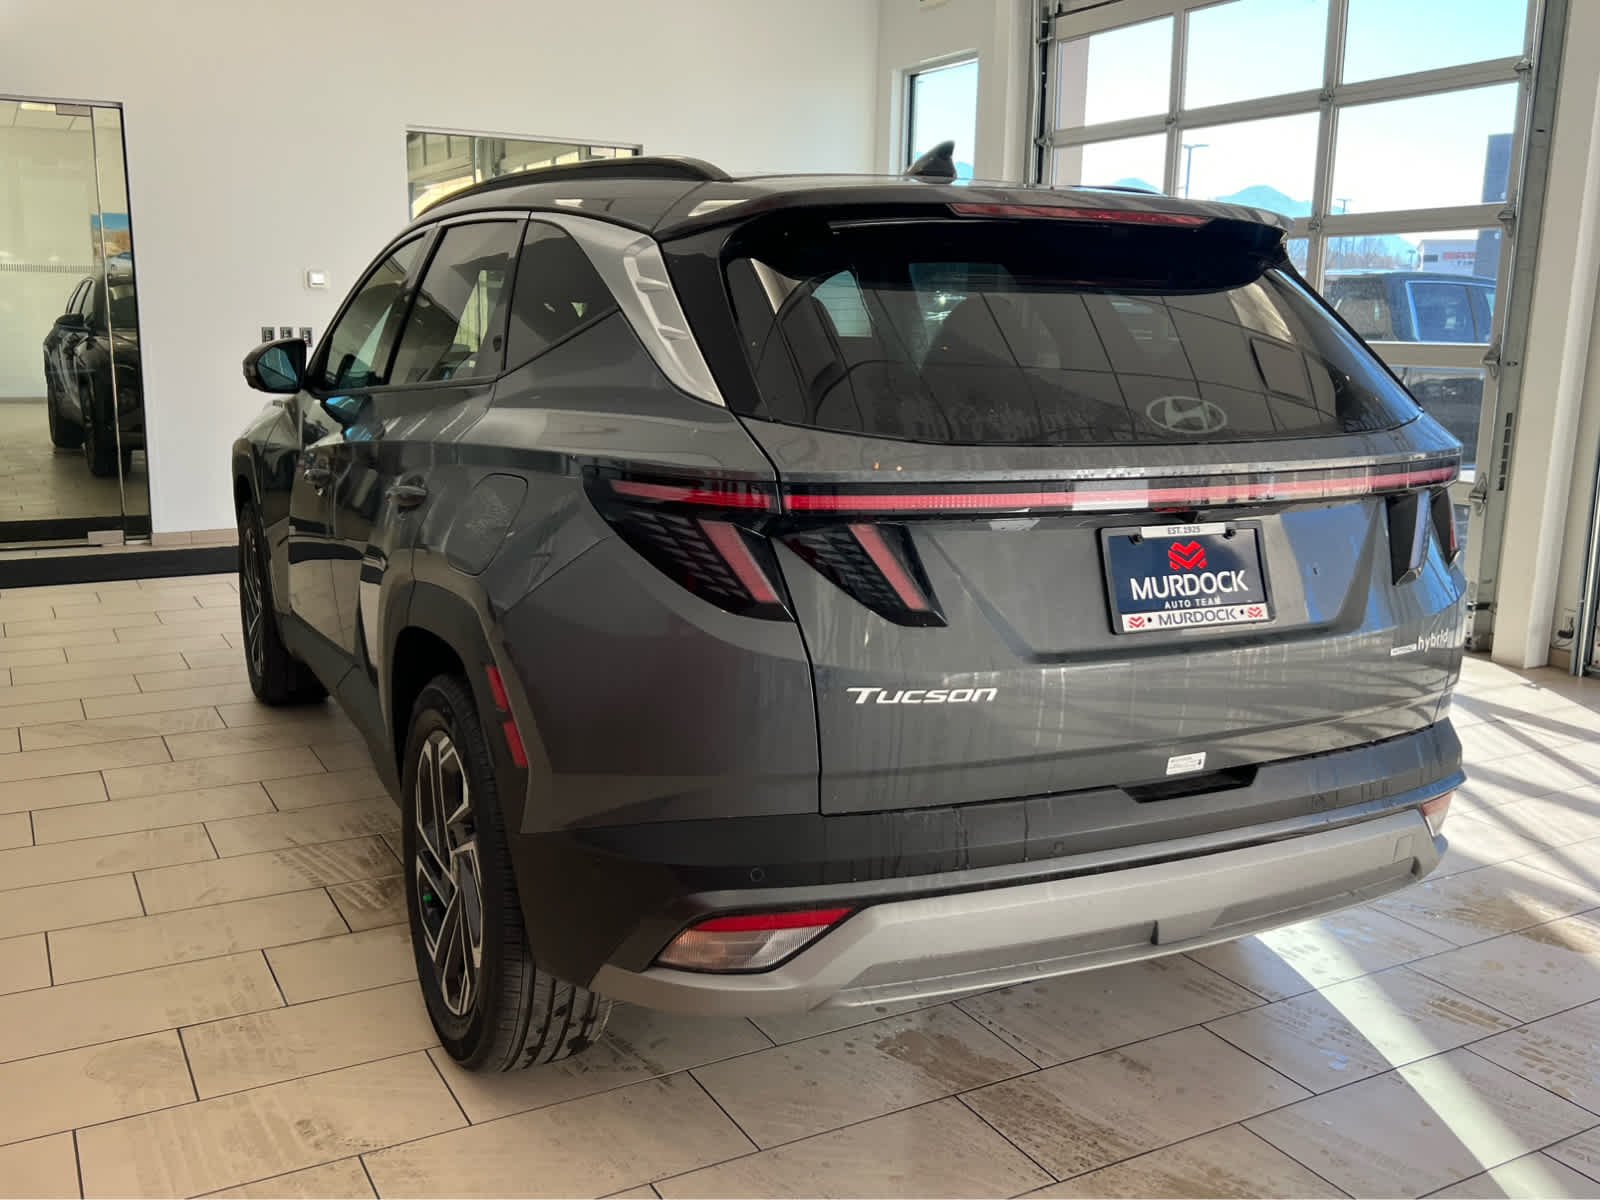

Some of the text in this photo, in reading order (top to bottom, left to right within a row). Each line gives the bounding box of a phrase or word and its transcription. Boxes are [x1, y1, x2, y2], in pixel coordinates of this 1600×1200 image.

[1130, 569, 1249, 601] MURDOCK
[1164, 596, 1222, 609] AUTO TEAM
[1158, 607, 1237, 626] MURDOCK
[1417, 627, 1449, 653] hybrid
